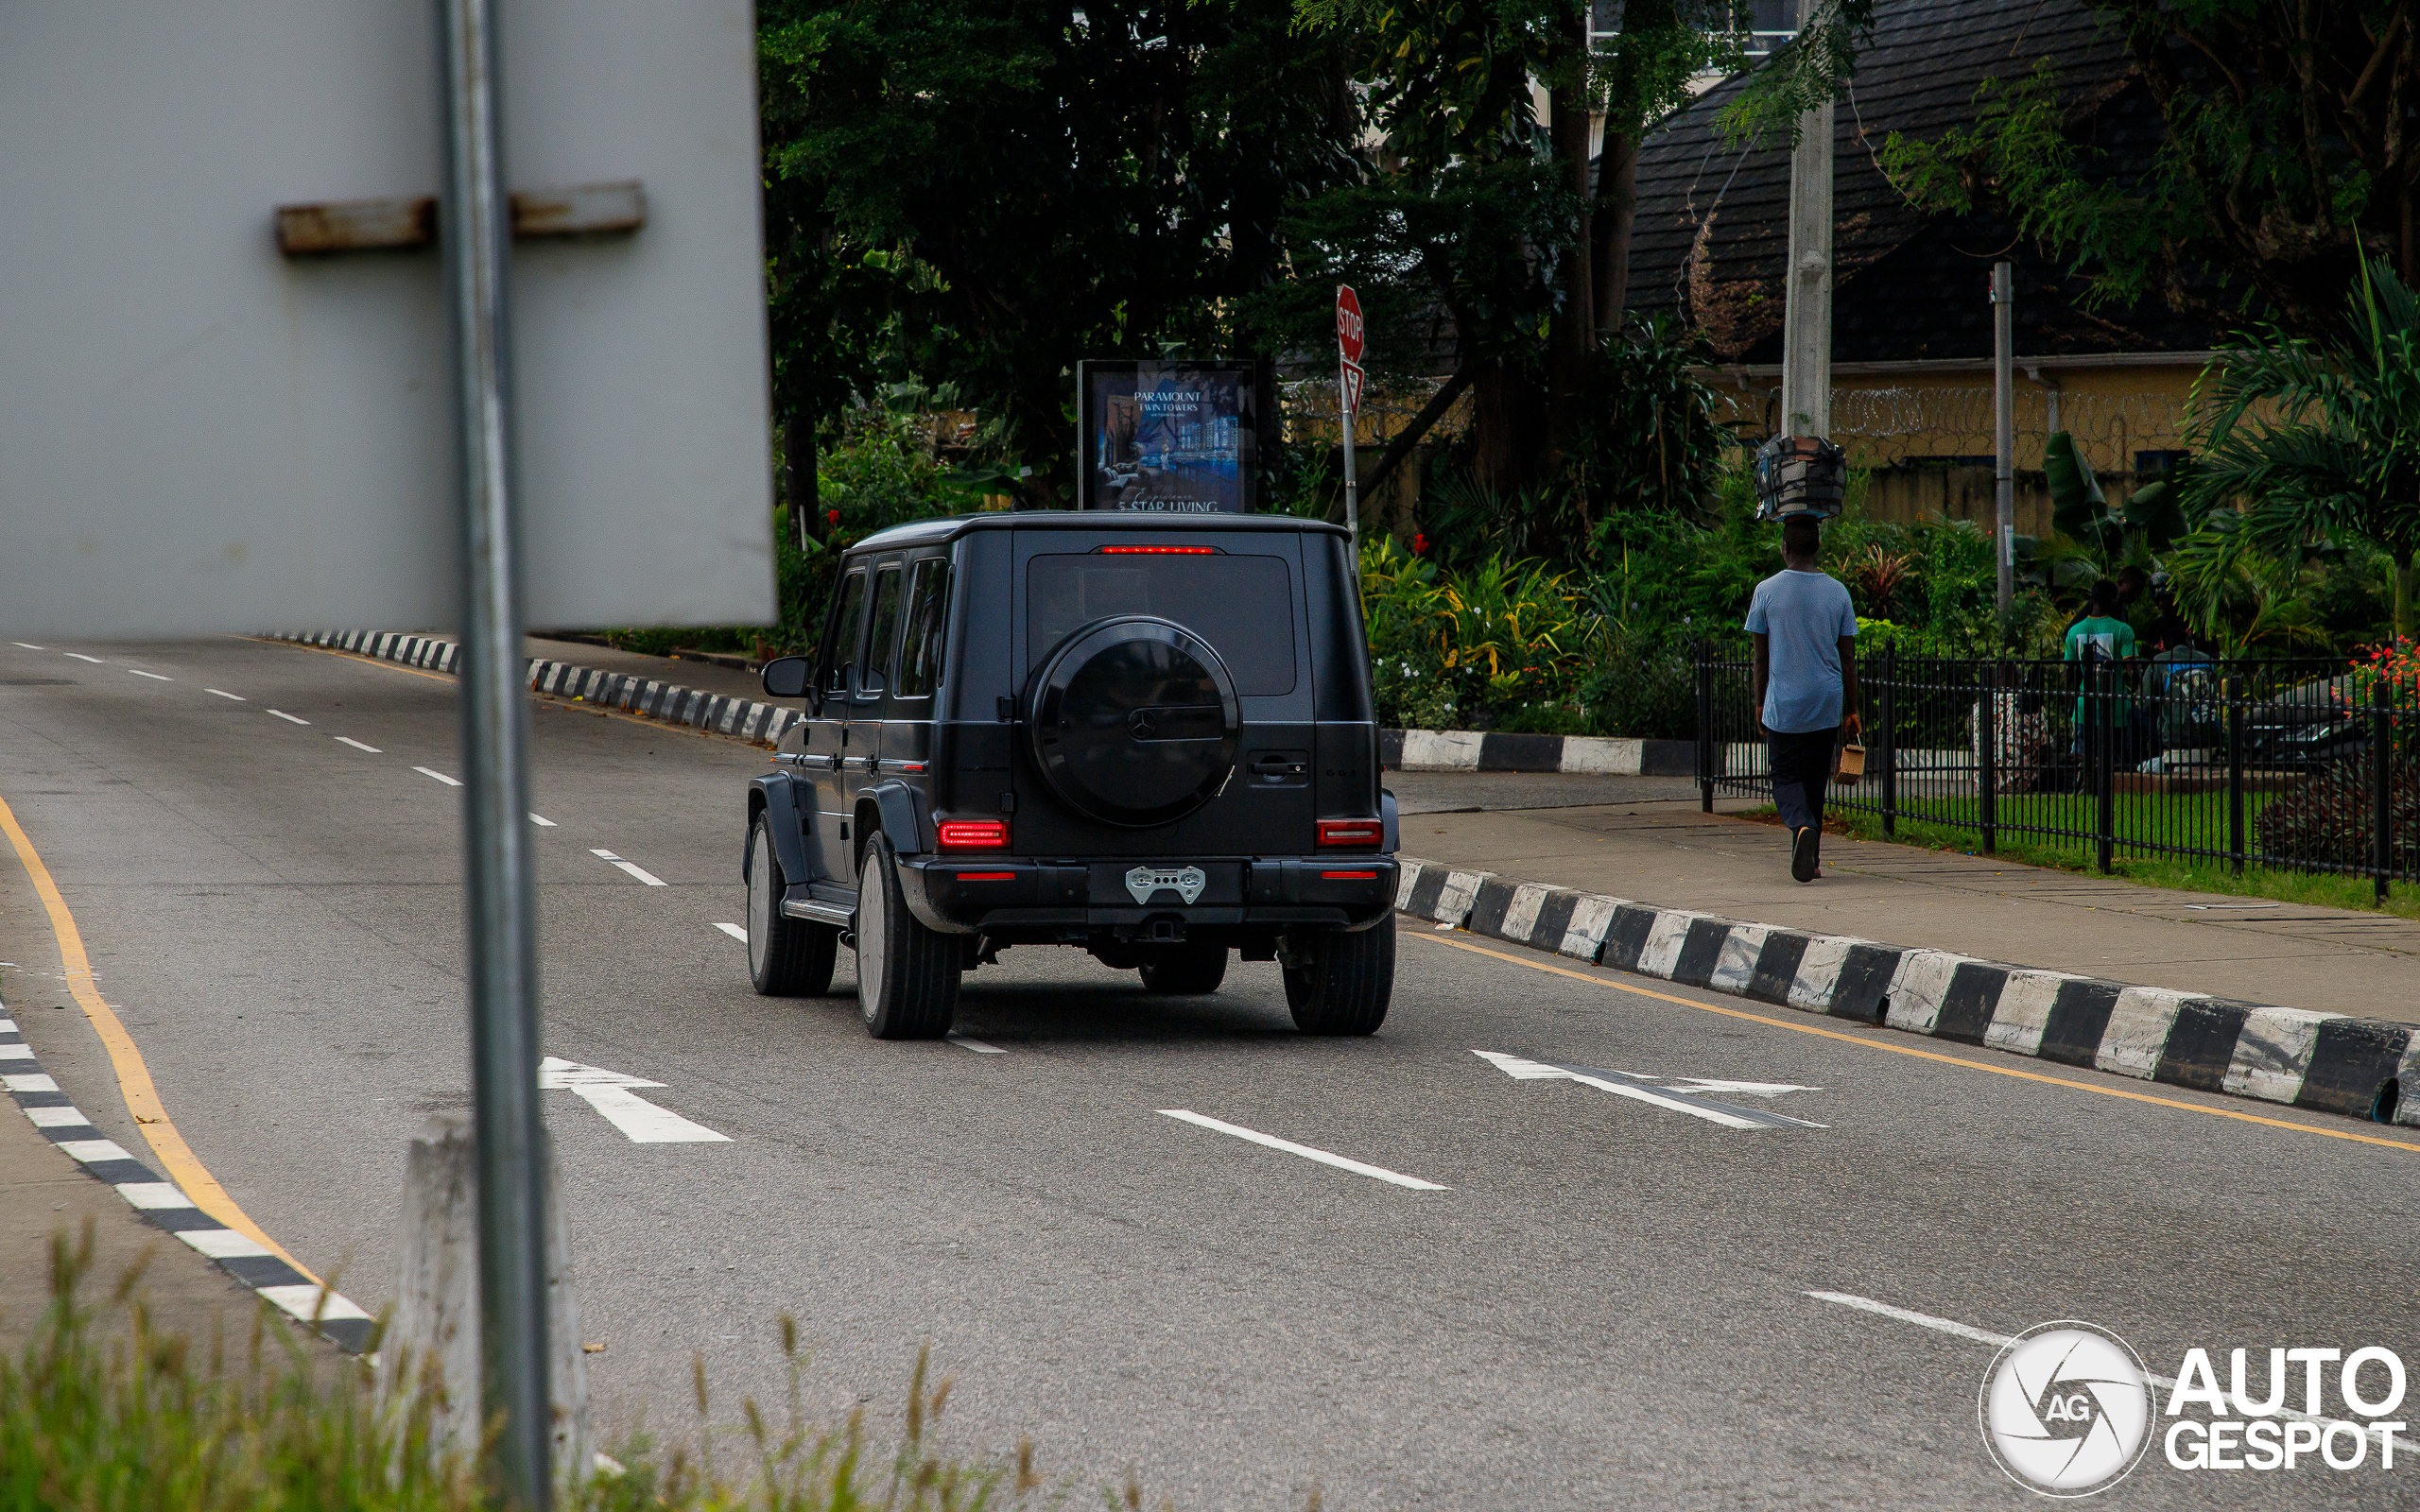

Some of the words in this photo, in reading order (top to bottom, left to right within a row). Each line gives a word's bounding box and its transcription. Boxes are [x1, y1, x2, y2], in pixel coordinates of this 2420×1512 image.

[1340, 306, 1361, 342] STOP
[1134, 391, 1201, 402] PARAMOUNT
[1163, 404, 1198, 412] TOWERS
